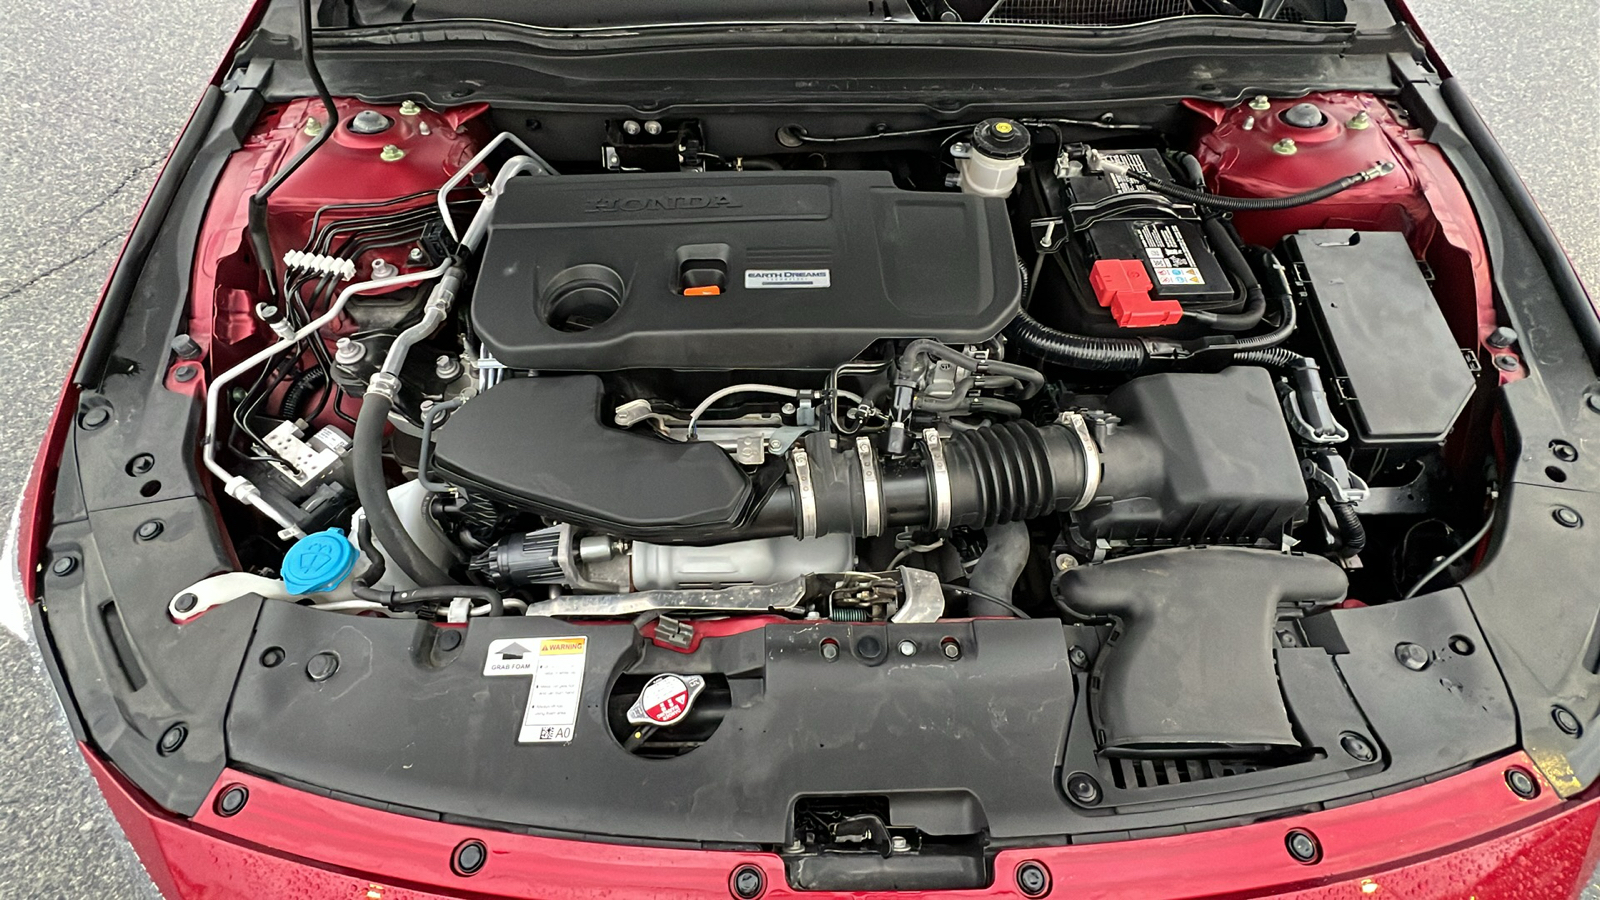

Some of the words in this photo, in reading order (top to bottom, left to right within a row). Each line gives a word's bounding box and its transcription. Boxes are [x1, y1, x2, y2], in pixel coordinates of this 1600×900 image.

[584, 196, 743, 213] HONDA
[549, 642, 583, 651] WARNING
[554, 727, 571, 739] A0
